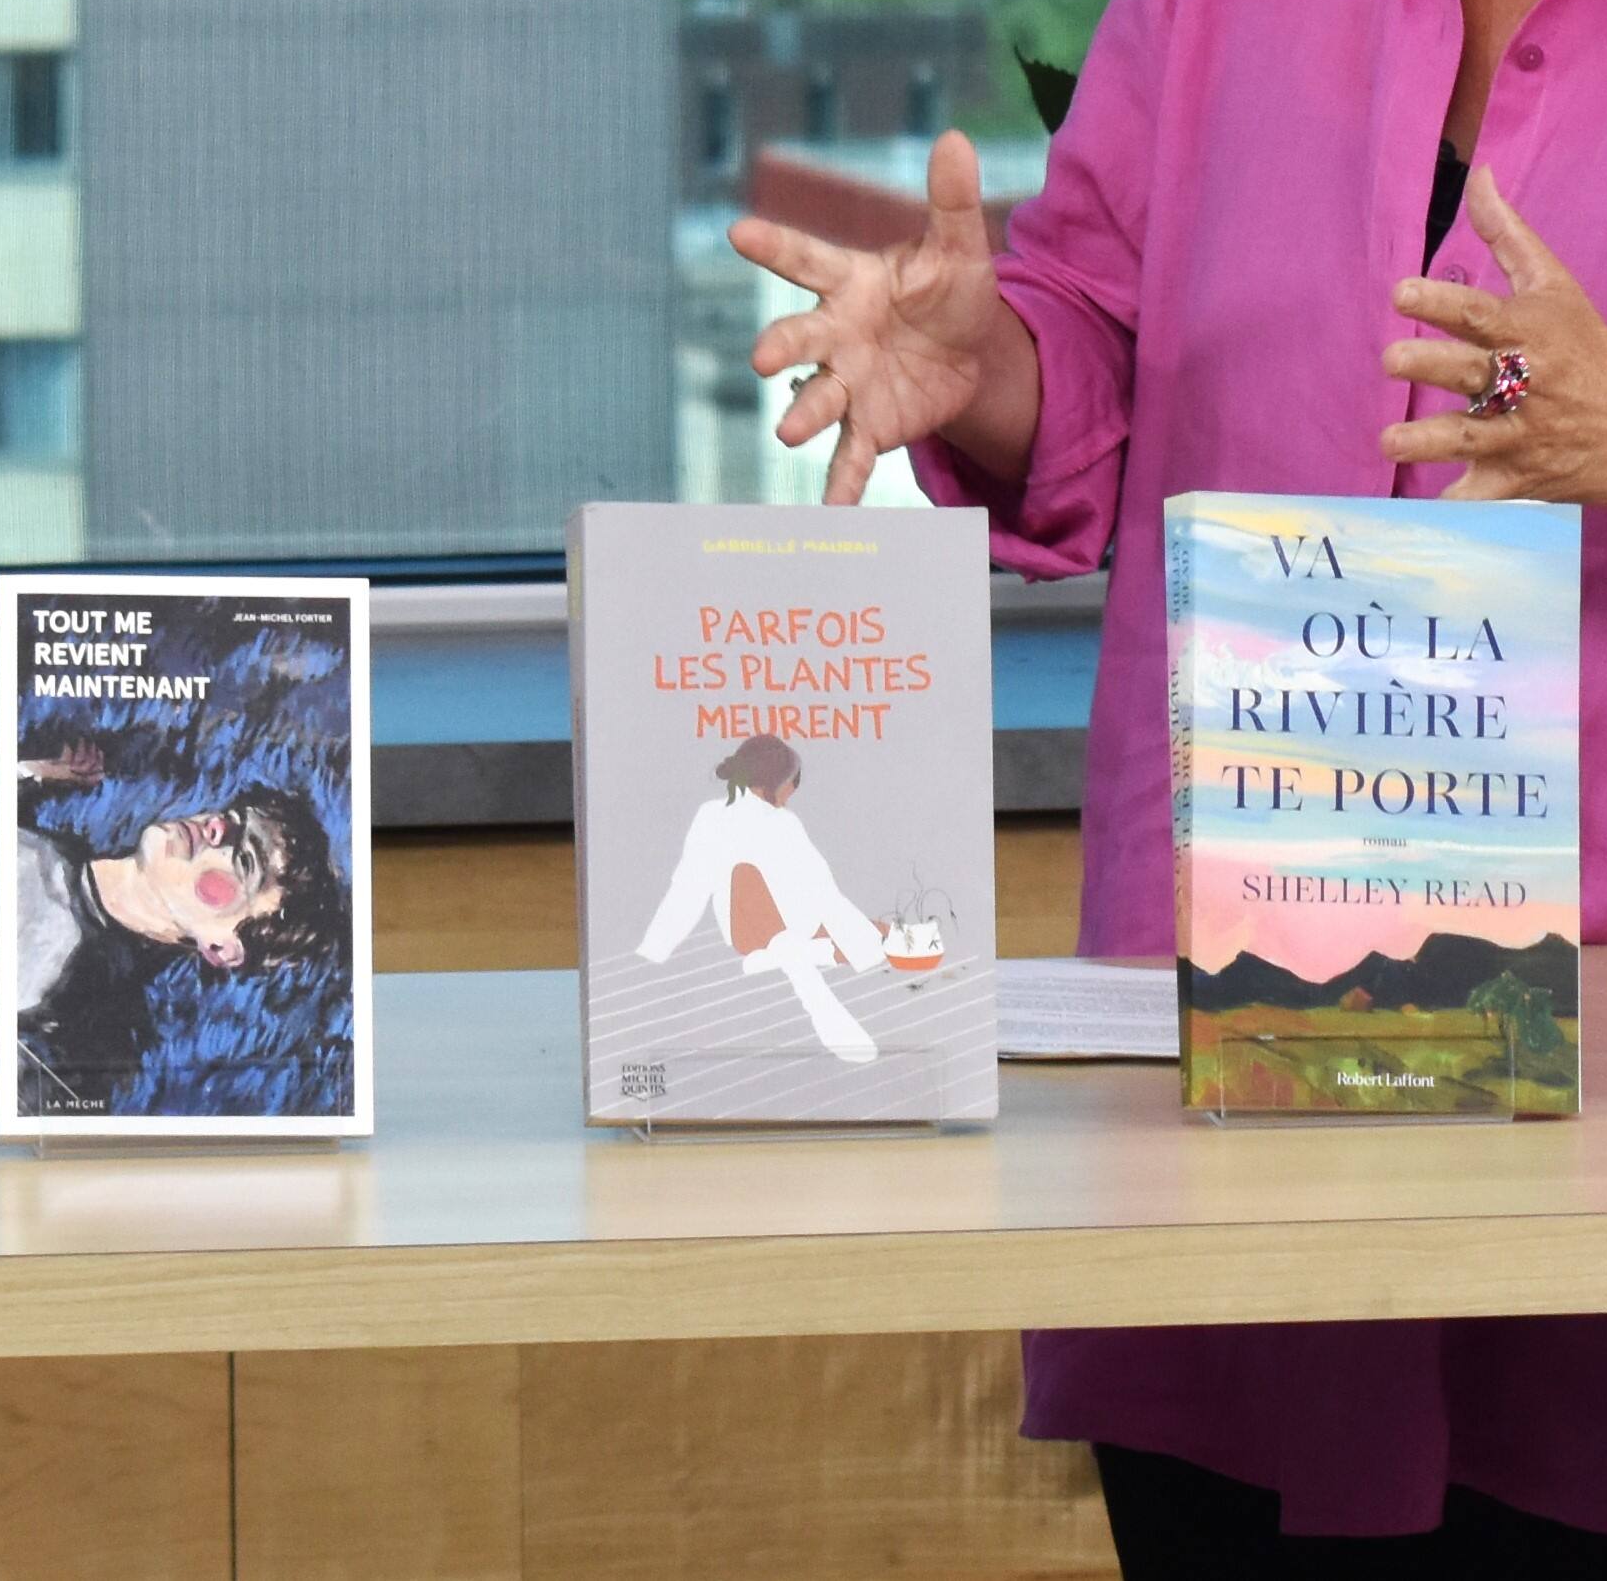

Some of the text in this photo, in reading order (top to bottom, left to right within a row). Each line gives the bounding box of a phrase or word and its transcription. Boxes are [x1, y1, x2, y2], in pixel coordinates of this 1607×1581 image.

[1270, 534, 1344, 579] VA
[33, 610, 153, 634] TOUT ME
[234, 613, 332, 623] JEAN-MICHEL FORTIER
[699, 606, 885, 648] PARFOIS
[1302, 600, 1505, 661] OÙ LA
[34, 643, 147, 666] REVIENT
[34, 675, 211, 699] MAINTENANT
[654, 653, 931, 693] LES PLANTES
[696, 704, 891, 740] MEURENT
[1228, 678, 1509, 740] RIVIÈRE
[1221, 765, 1549, 819] TE PORTE
[1362, 837, 1407, 847] roman
[1242, 874, 1527, 908] SHELLEY READ
[1336, 1071, 1435, 1088] Robert Laffont
[46, 1100, 61, 1108] LA
